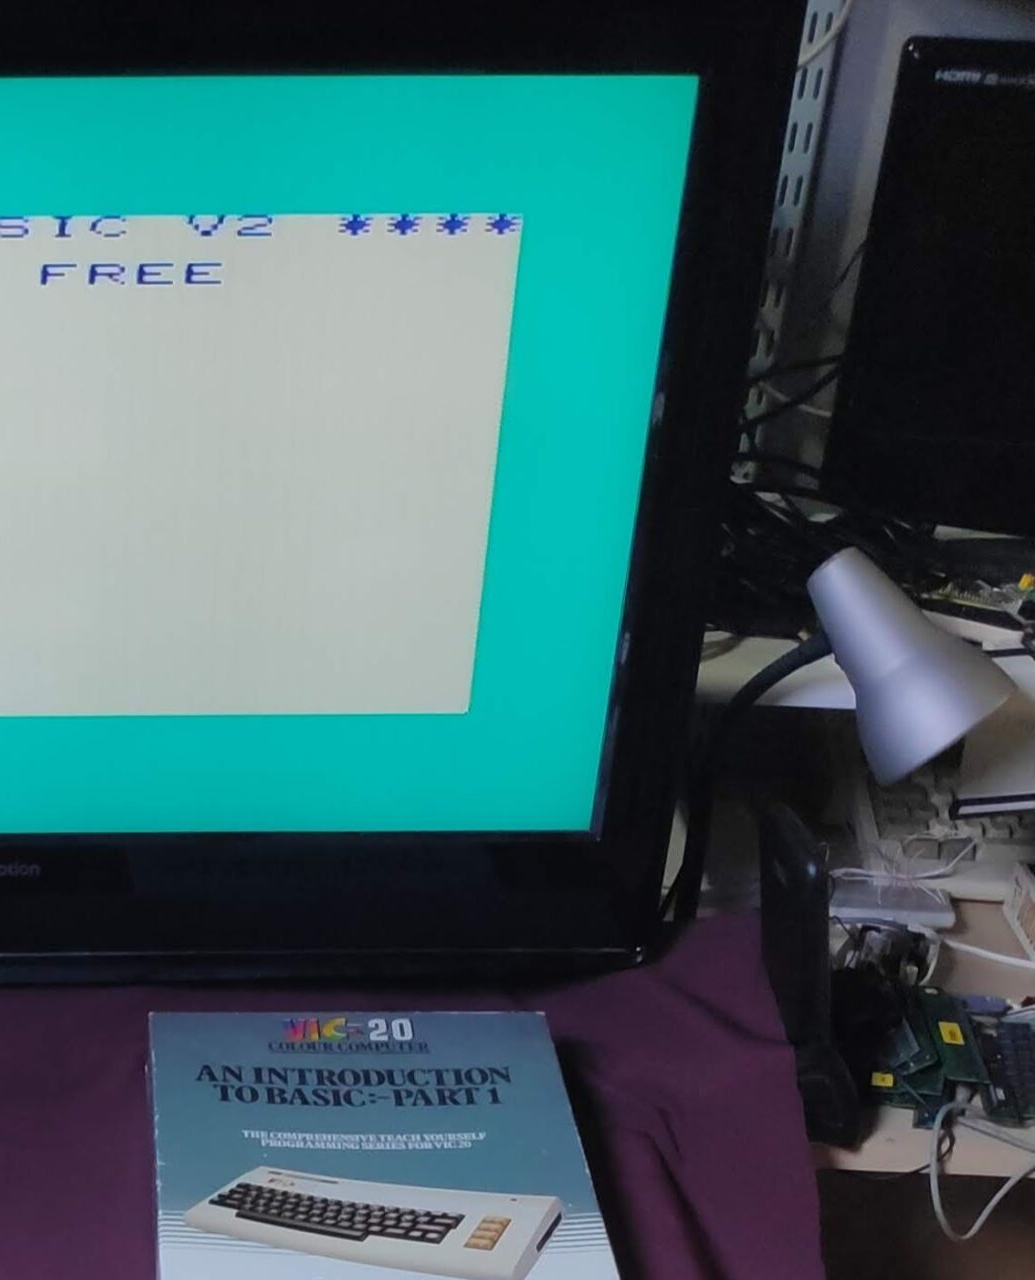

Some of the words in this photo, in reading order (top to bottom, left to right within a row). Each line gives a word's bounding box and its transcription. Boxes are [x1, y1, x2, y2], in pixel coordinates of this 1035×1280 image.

[188, 214, 274, 238] V2
[40, 263, 223, 285] FREE
[267, 1041, 332, 1052] COLOUR
[336, 1041, 429, 1052] COMPUTER
[195, 1064, 242, 1083] AN
[252, 1066, 512, 1087] INTRODUCTION
[213, 1084, 260, 1104] TO
[487, 1086, 502, 1105] 1
[241, 1129, 267, 1139] THE
[269, 1132, 375, 1143] COMPREHENSIVE
[375, 1133, 416, 1142] TEACH
[417, 1132, 487, 1142] YOURSELF
[260, 1139, 361, 1149] PROGRAMMING
